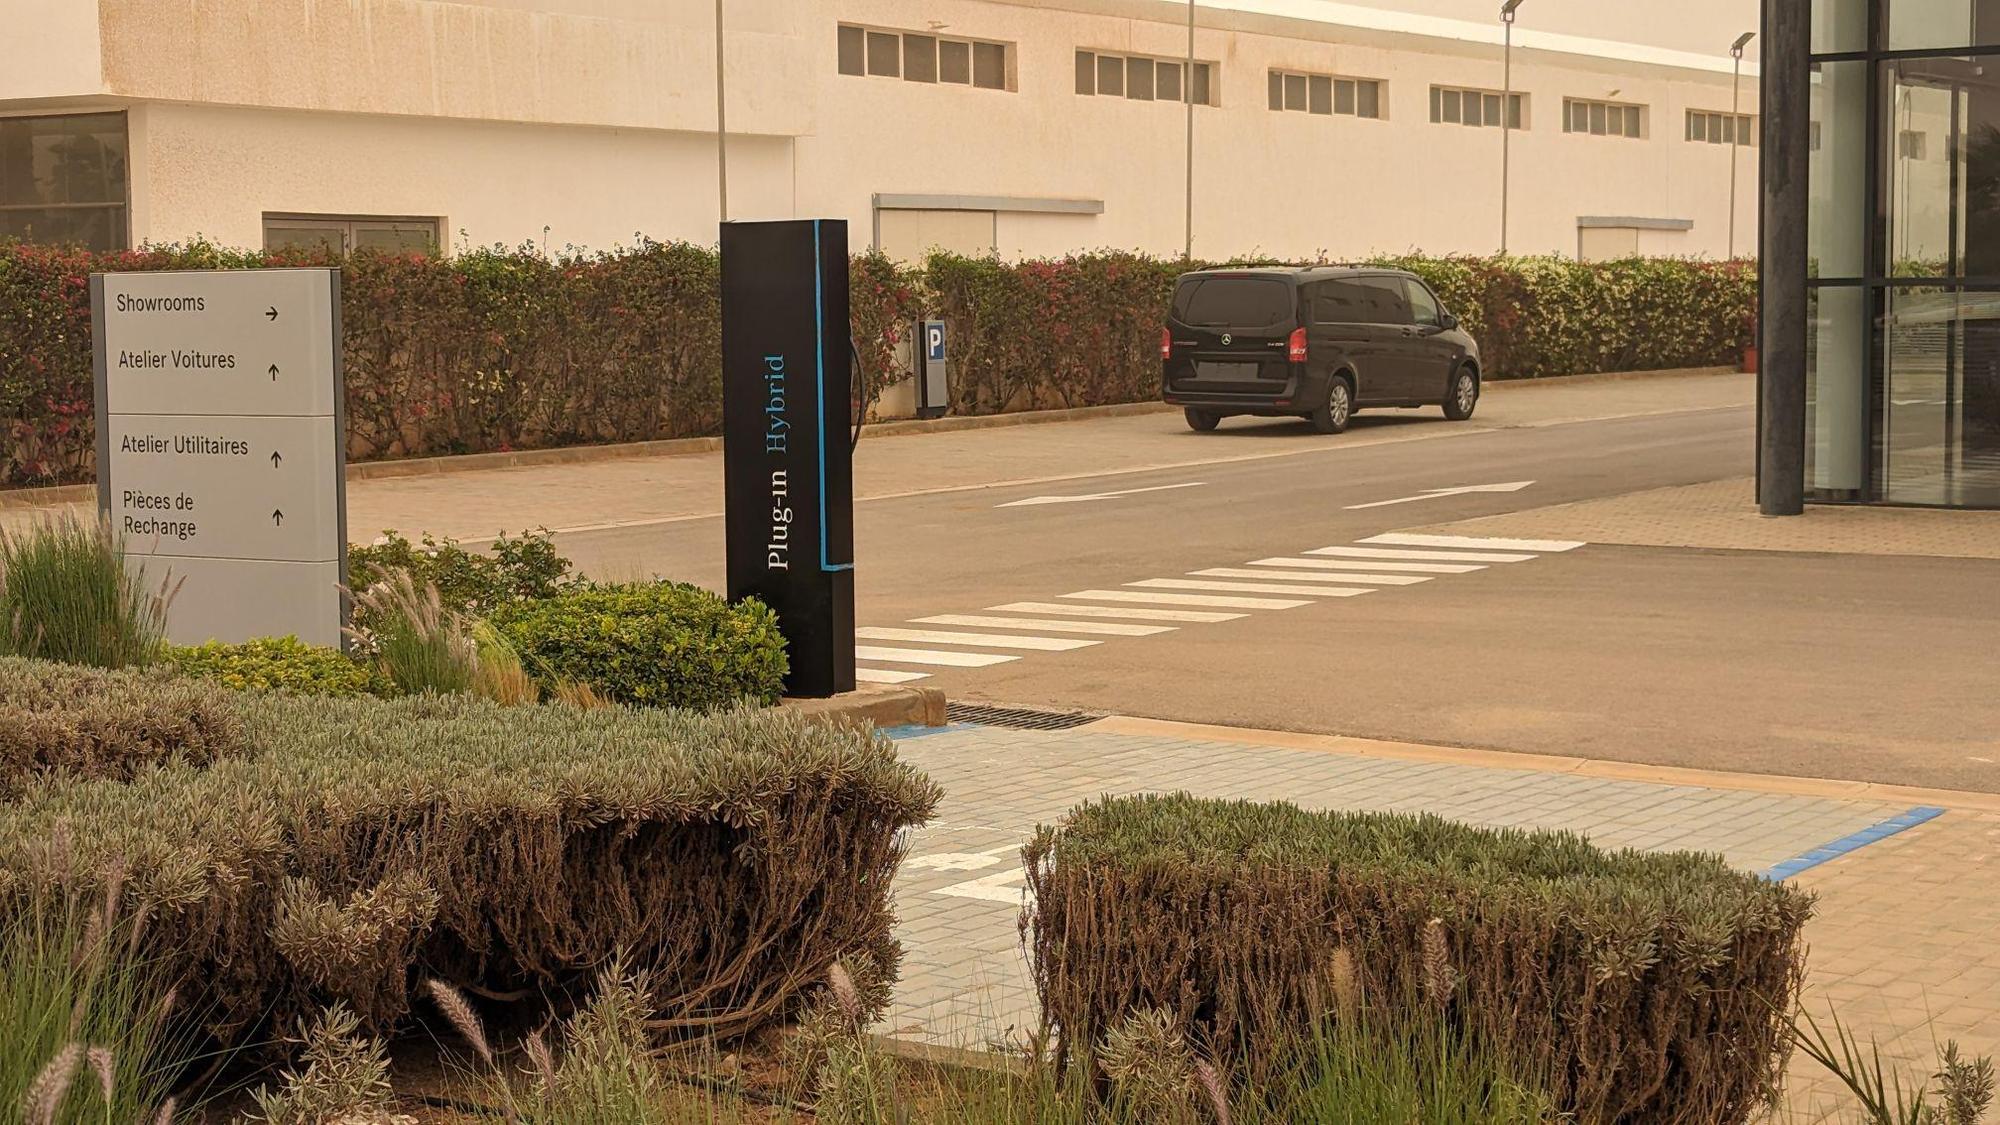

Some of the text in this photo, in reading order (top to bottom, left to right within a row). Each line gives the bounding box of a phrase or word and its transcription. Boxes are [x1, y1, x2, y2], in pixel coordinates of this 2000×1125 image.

[116, 293, 205, 312] Showrooms
[929, 328, 941, 356] P
[118, 350, 236, 369] Atelier Voitures
[121, 434, 249, 456] Atelier Utilitaires
[764, 353, 793, 571] Plug-in Hybrid
[123, 490, 194, 511] Pièces de
[124, 515, 197, 541] Rechange
